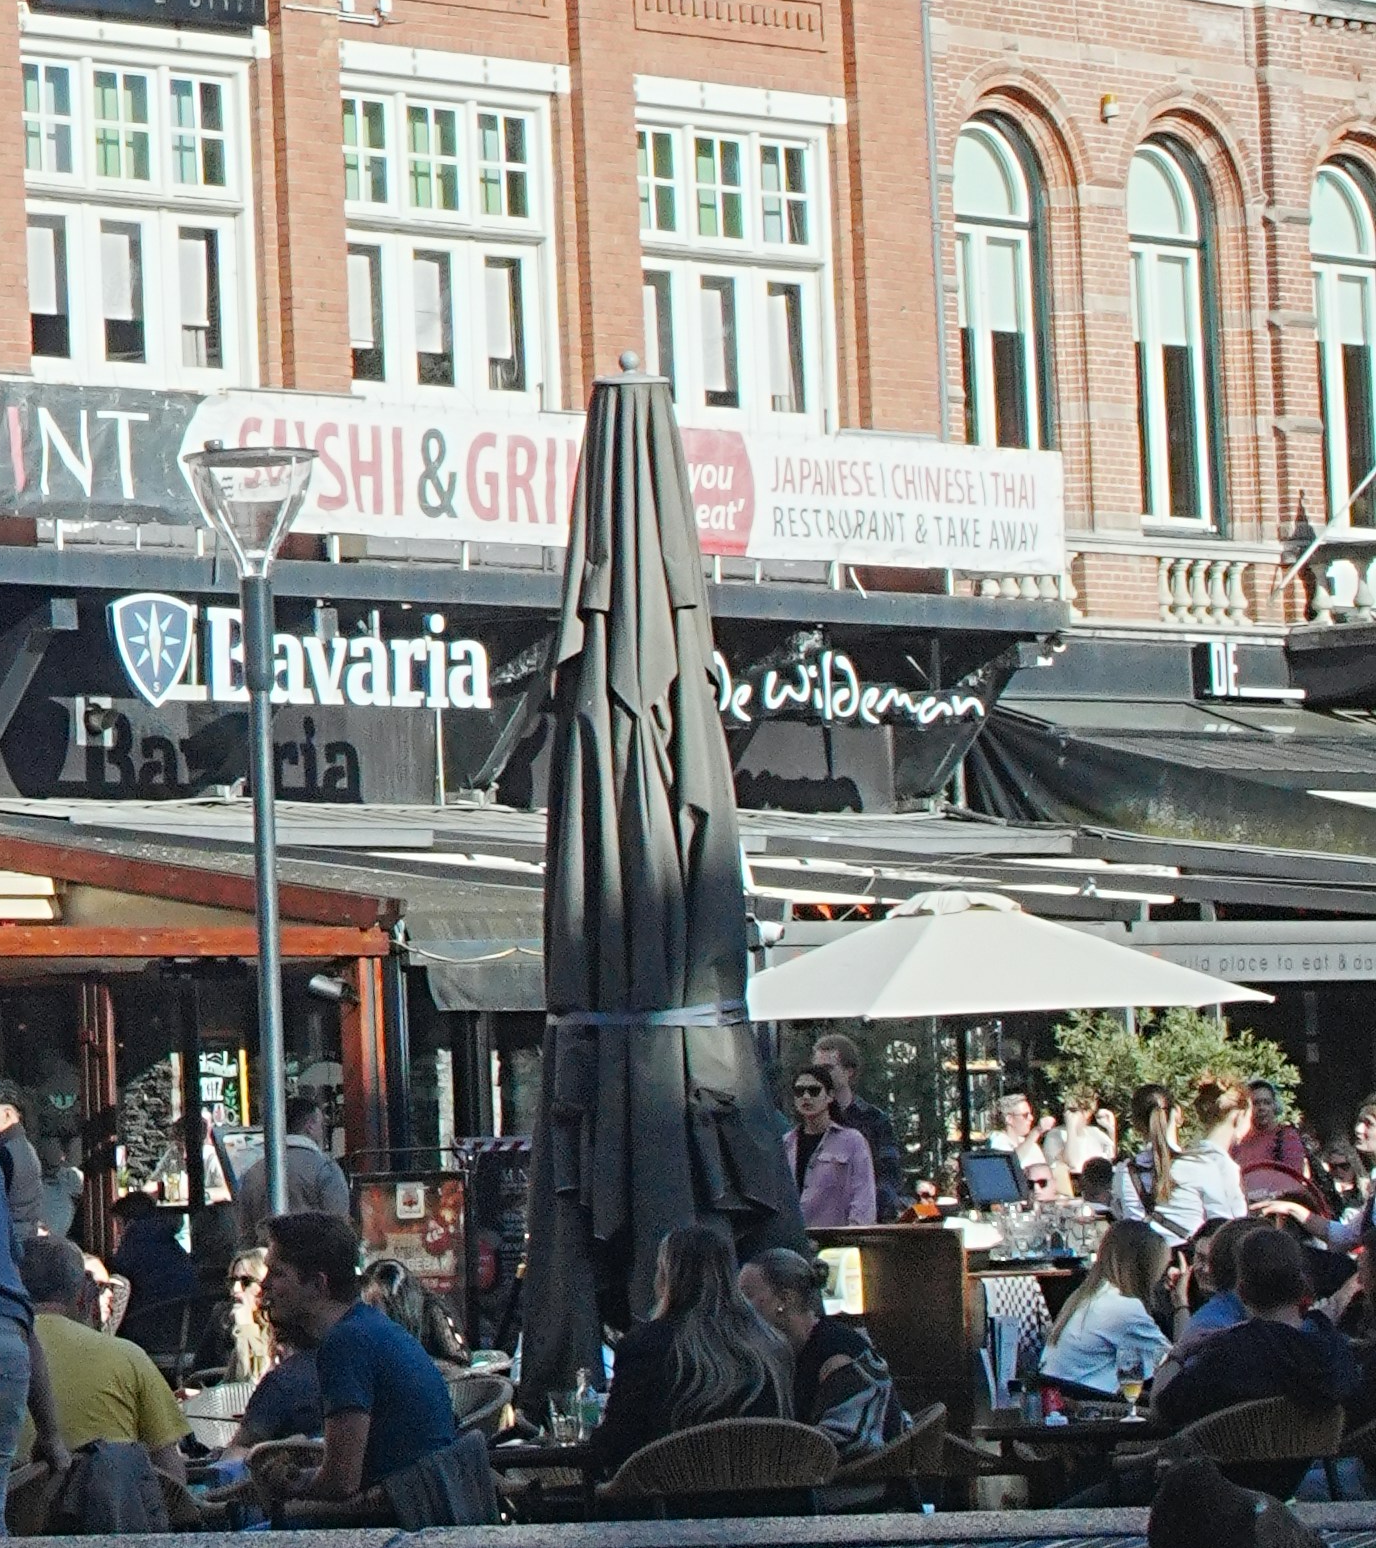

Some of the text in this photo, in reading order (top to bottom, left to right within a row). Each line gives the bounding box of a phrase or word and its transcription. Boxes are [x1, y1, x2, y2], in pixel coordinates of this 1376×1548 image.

[238, 416, 405, 518] SUSHI
[417, 428, 459, 519] &
[771, 456, 1035, 511] JAPANESE CHINESE THAI
[773, 506, 1039, 552] RESTAURANT & TAKE AWAY
[206, 605, 492, 709] Bavaria
[1218, 955, 1269, 977] place
